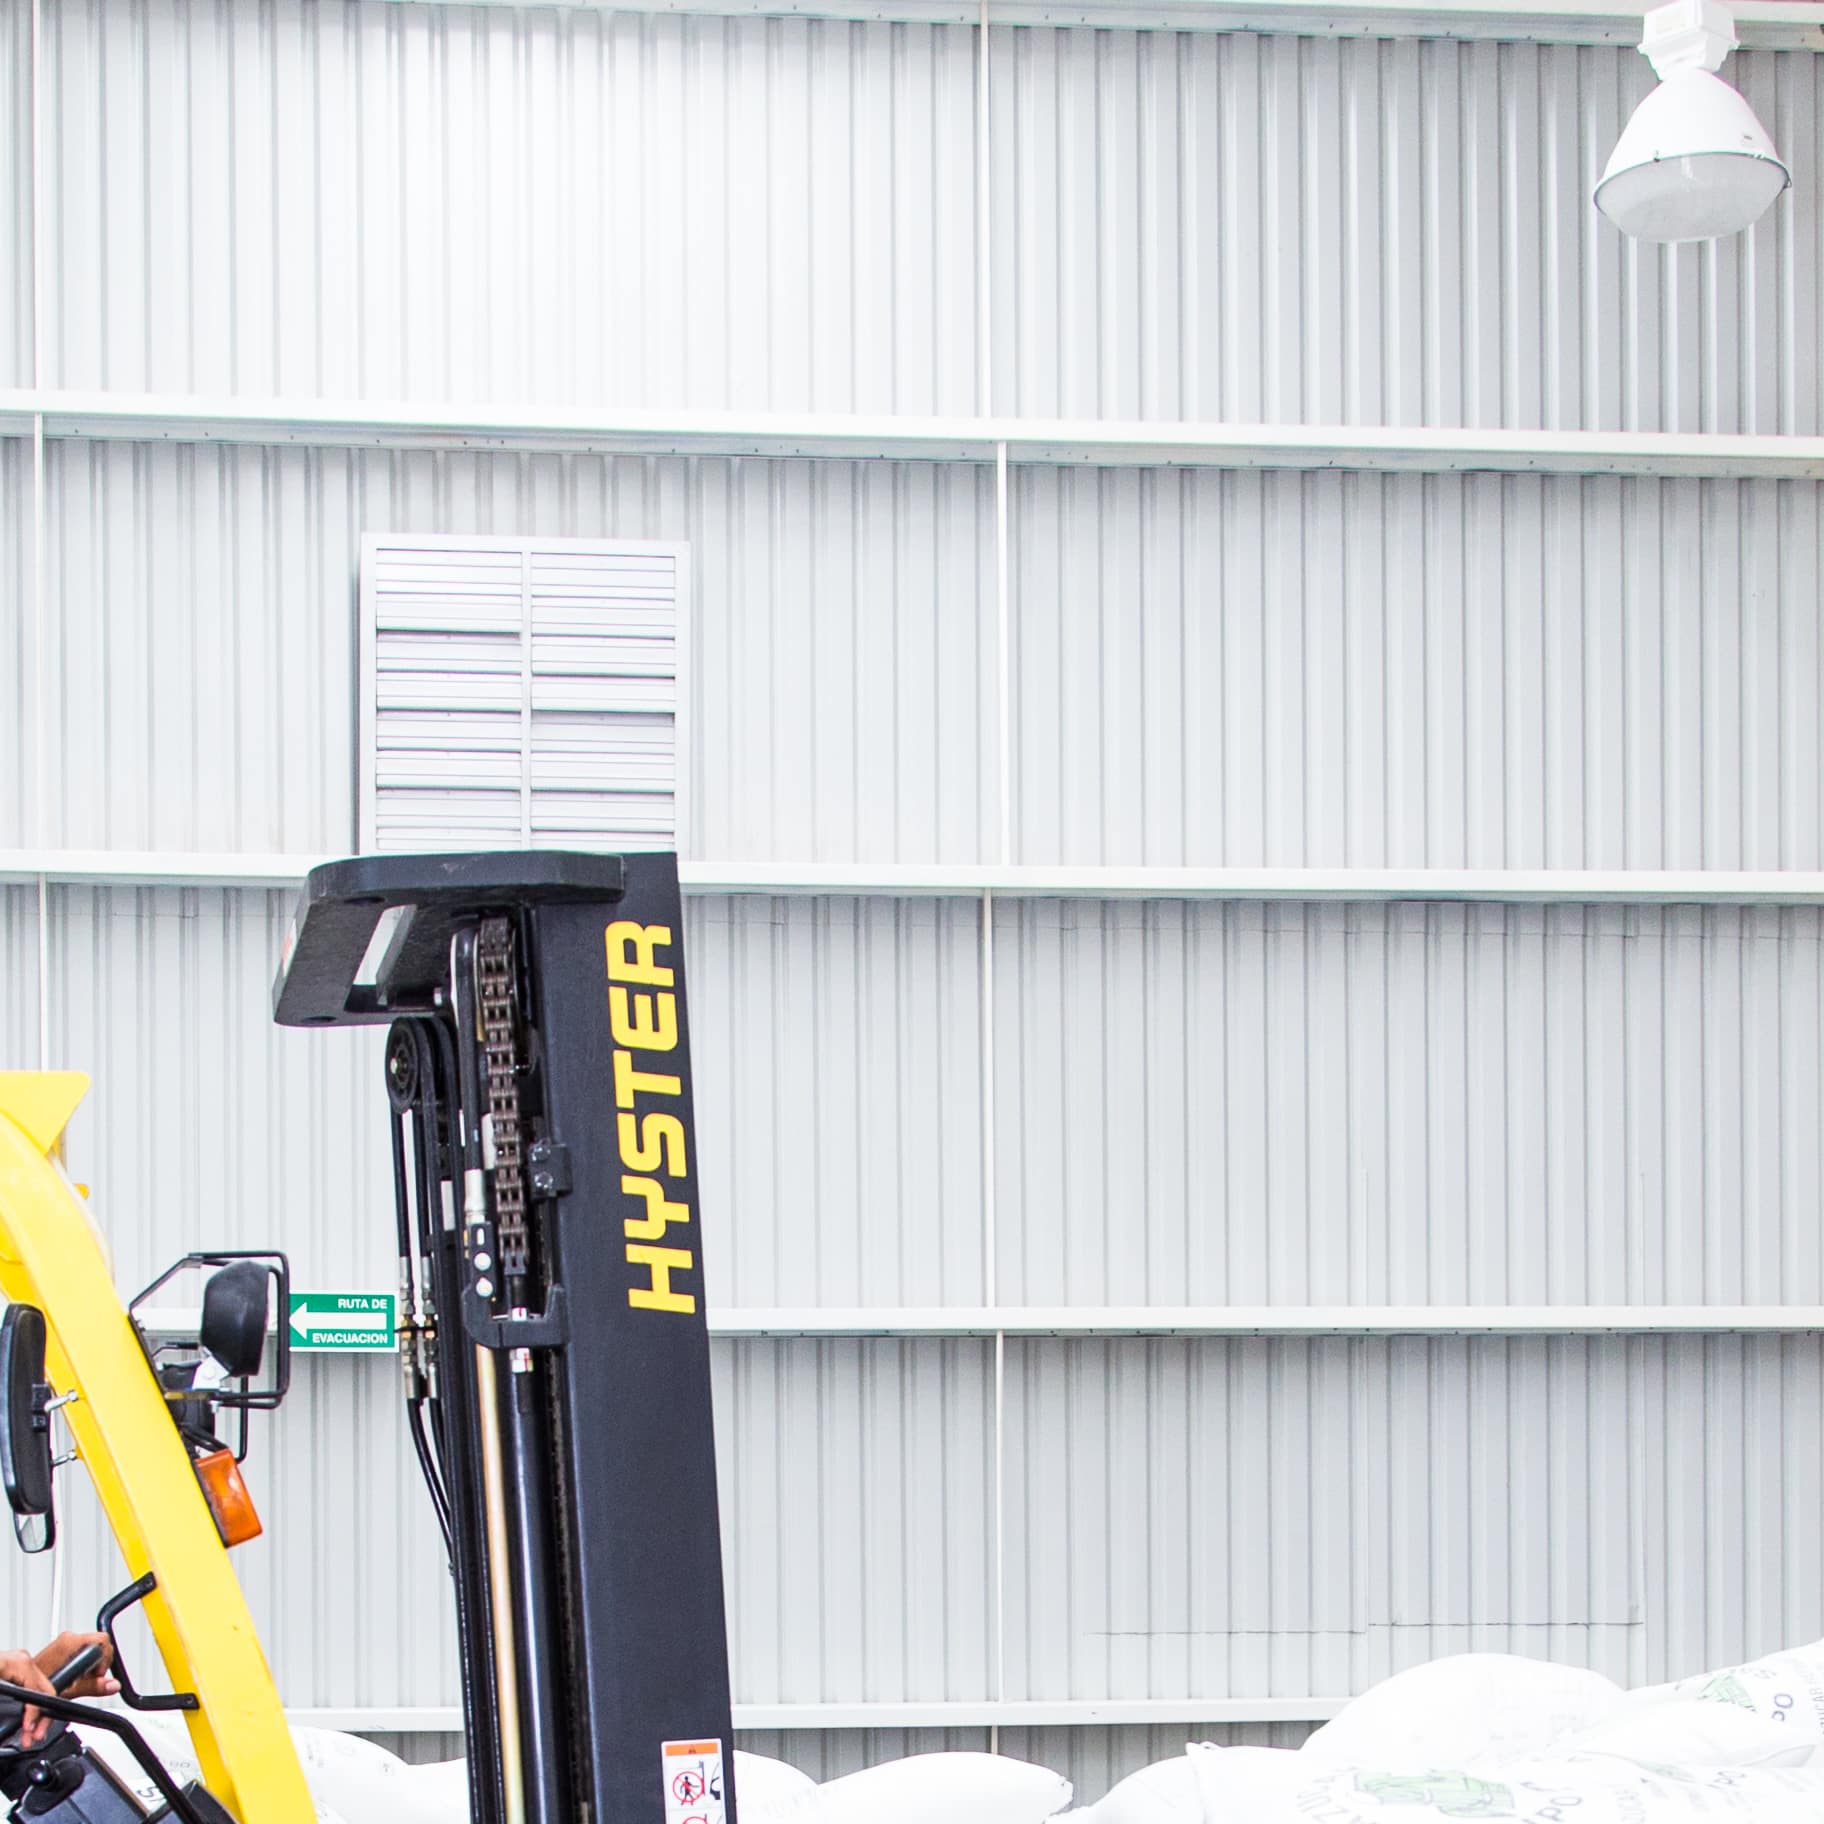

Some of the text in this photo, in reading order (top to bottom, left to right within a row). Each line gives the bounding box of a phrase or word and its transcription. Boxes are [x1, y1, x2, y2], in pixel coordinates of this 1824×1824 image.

[604, 918, 696, 1314] HYSTER
[337, 1298, 388, 1310] RUTA DE
[312, 1333, 388, 1344] EVACUACION
